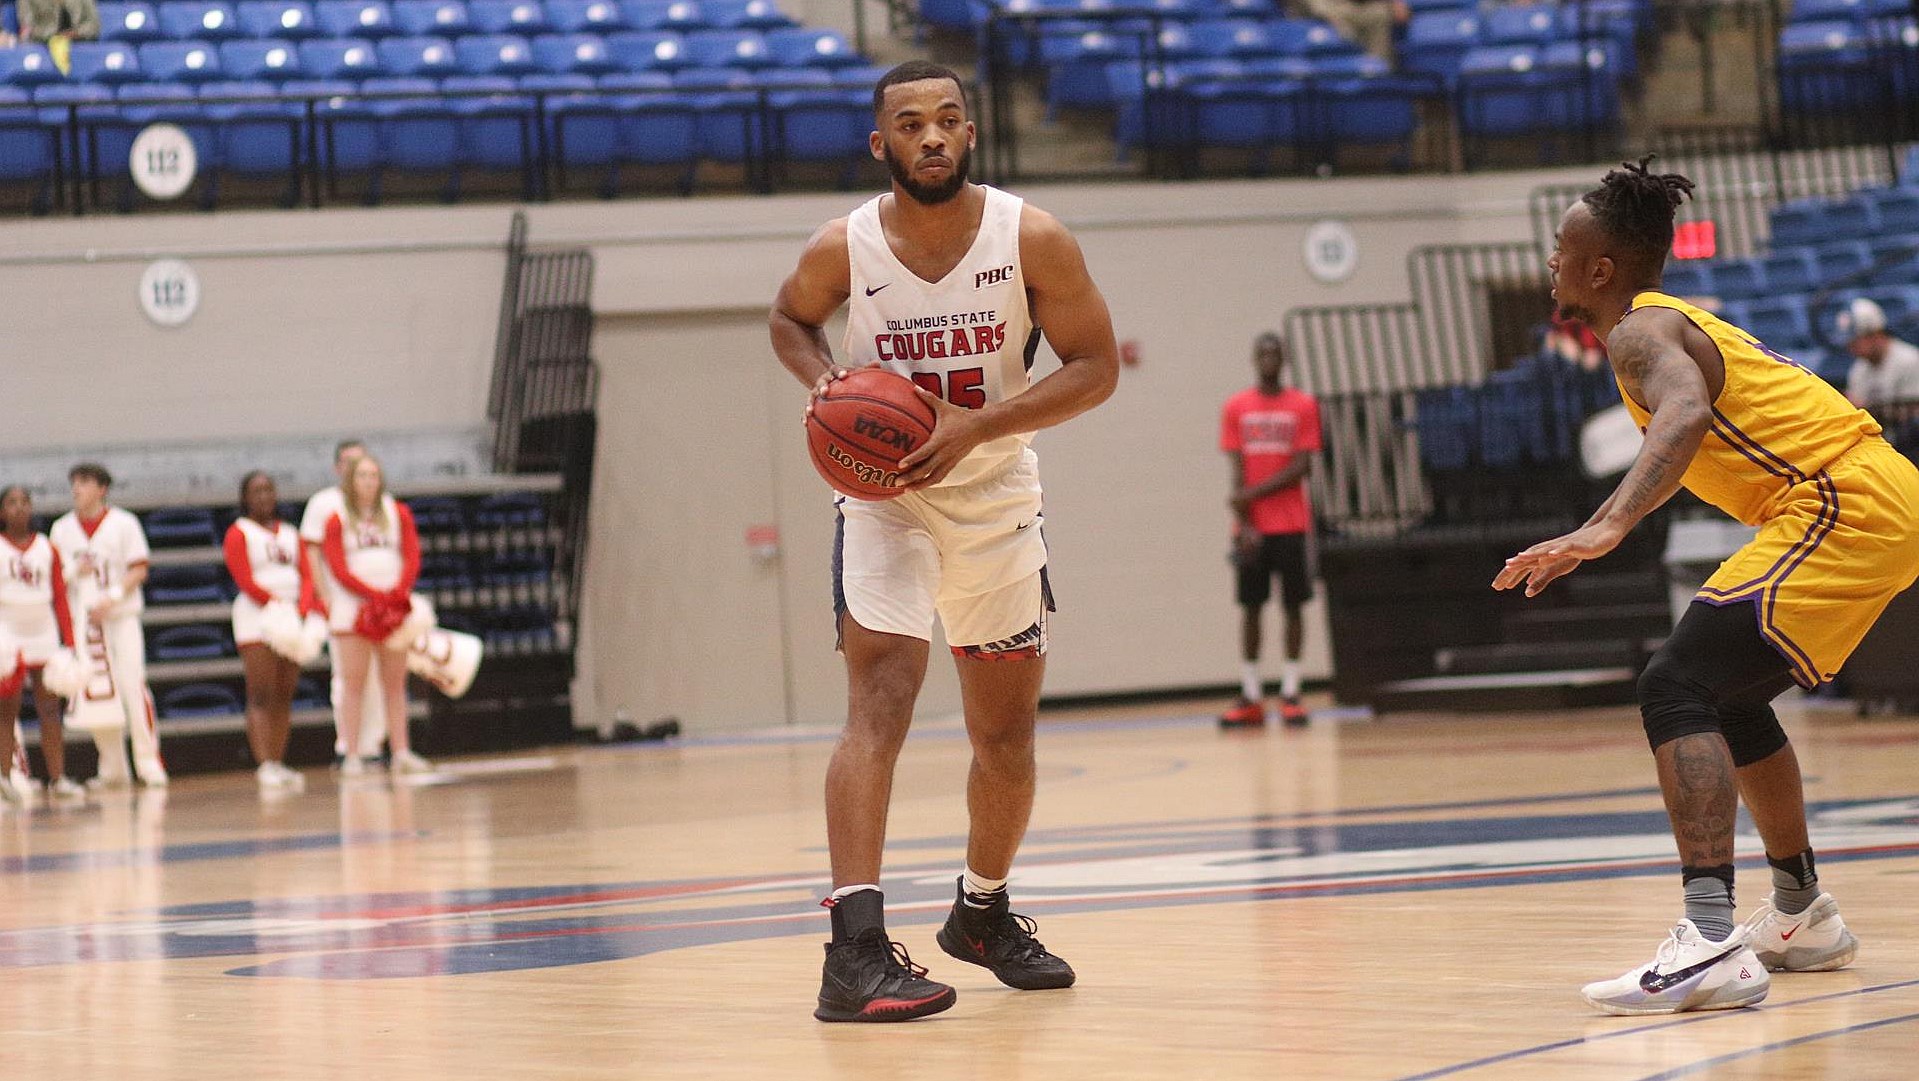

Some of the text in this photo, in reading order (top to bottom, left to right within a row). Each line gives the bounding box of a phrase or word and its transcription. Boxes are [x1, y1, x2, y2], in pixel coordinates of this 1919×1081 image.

[974, 264, 1014, 289] PBC
[886, 310, 996, 331] COLUMBUS STATE
[875, 320, 1007, 361] COUGARS
[854, 413, 917, 453] NCAA
